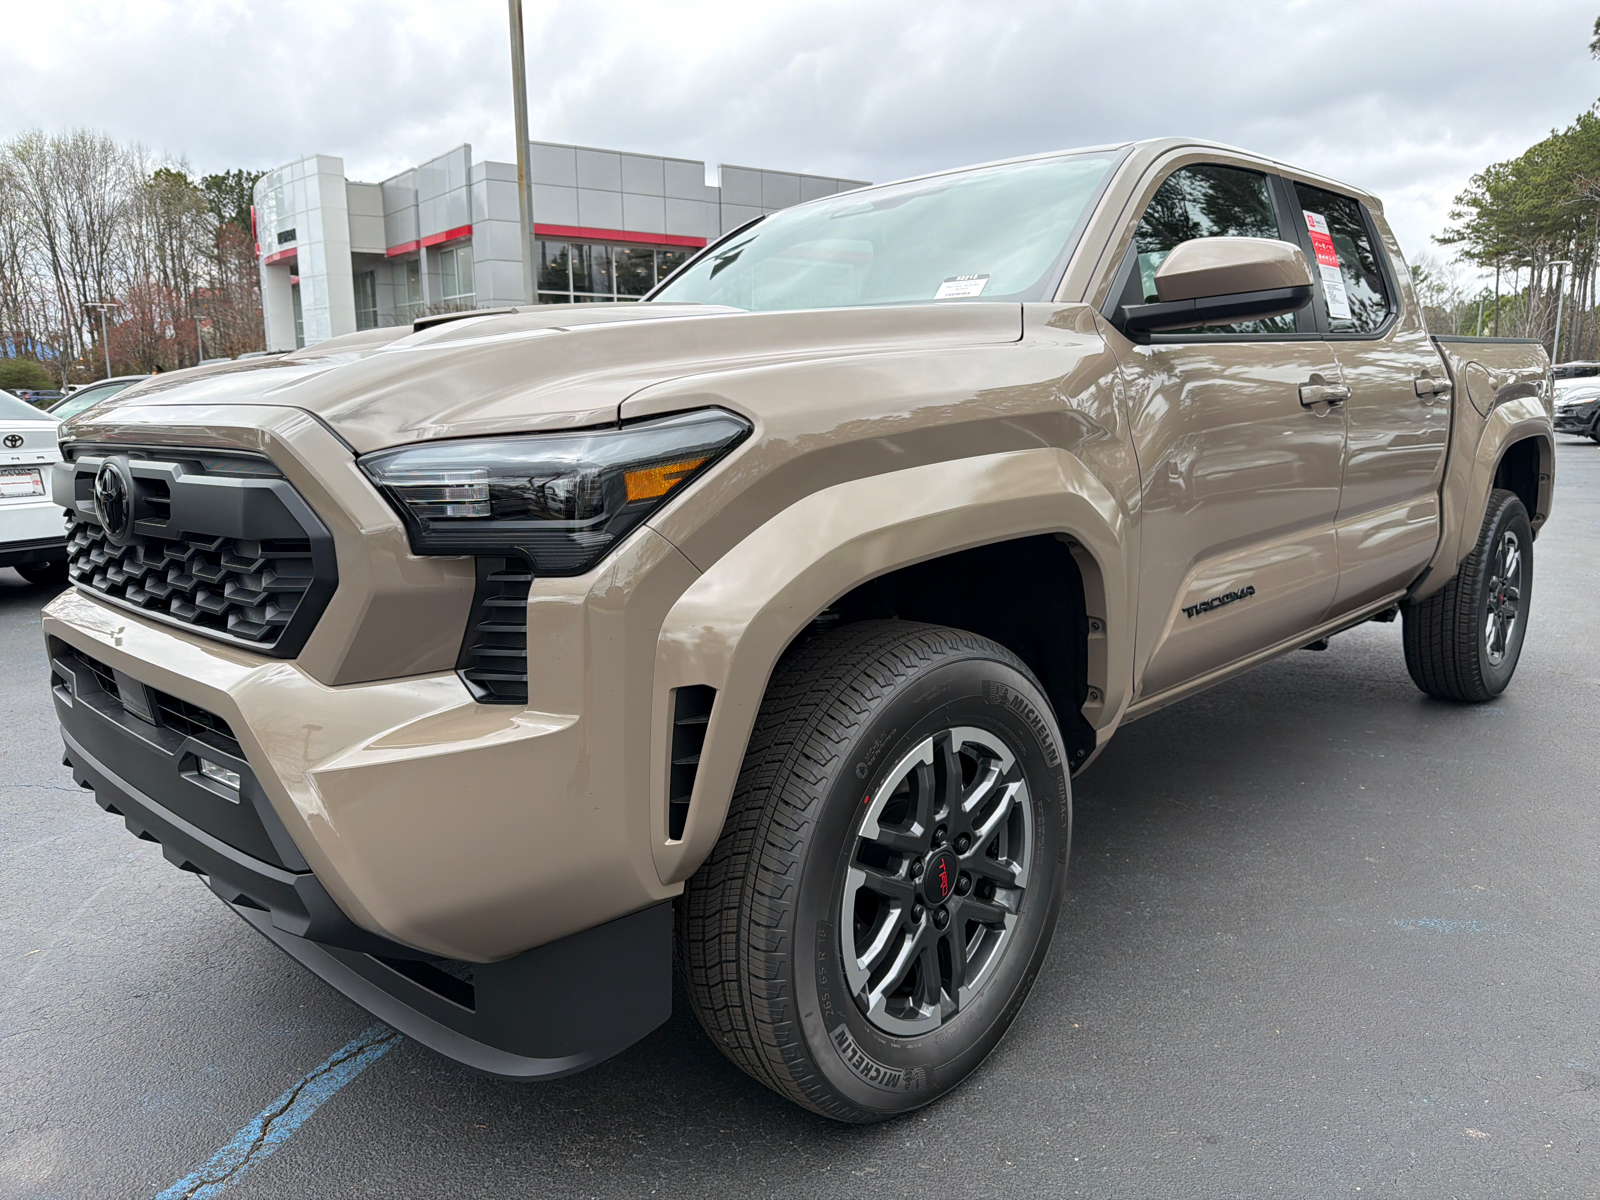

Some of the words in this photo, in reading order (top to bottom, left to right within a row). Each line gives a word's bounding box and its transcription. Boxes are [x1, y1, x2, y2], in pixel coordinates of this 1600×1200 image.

[1181, 585, 1255, 618] TACOMA
[1010, 695, 1058, 762] MICHELIN
[1057, 776, 1067, 828] PRIMACY
[939, 858, 948, 896] TRD
[834, 1030, 901, 1088] MICHELIN
